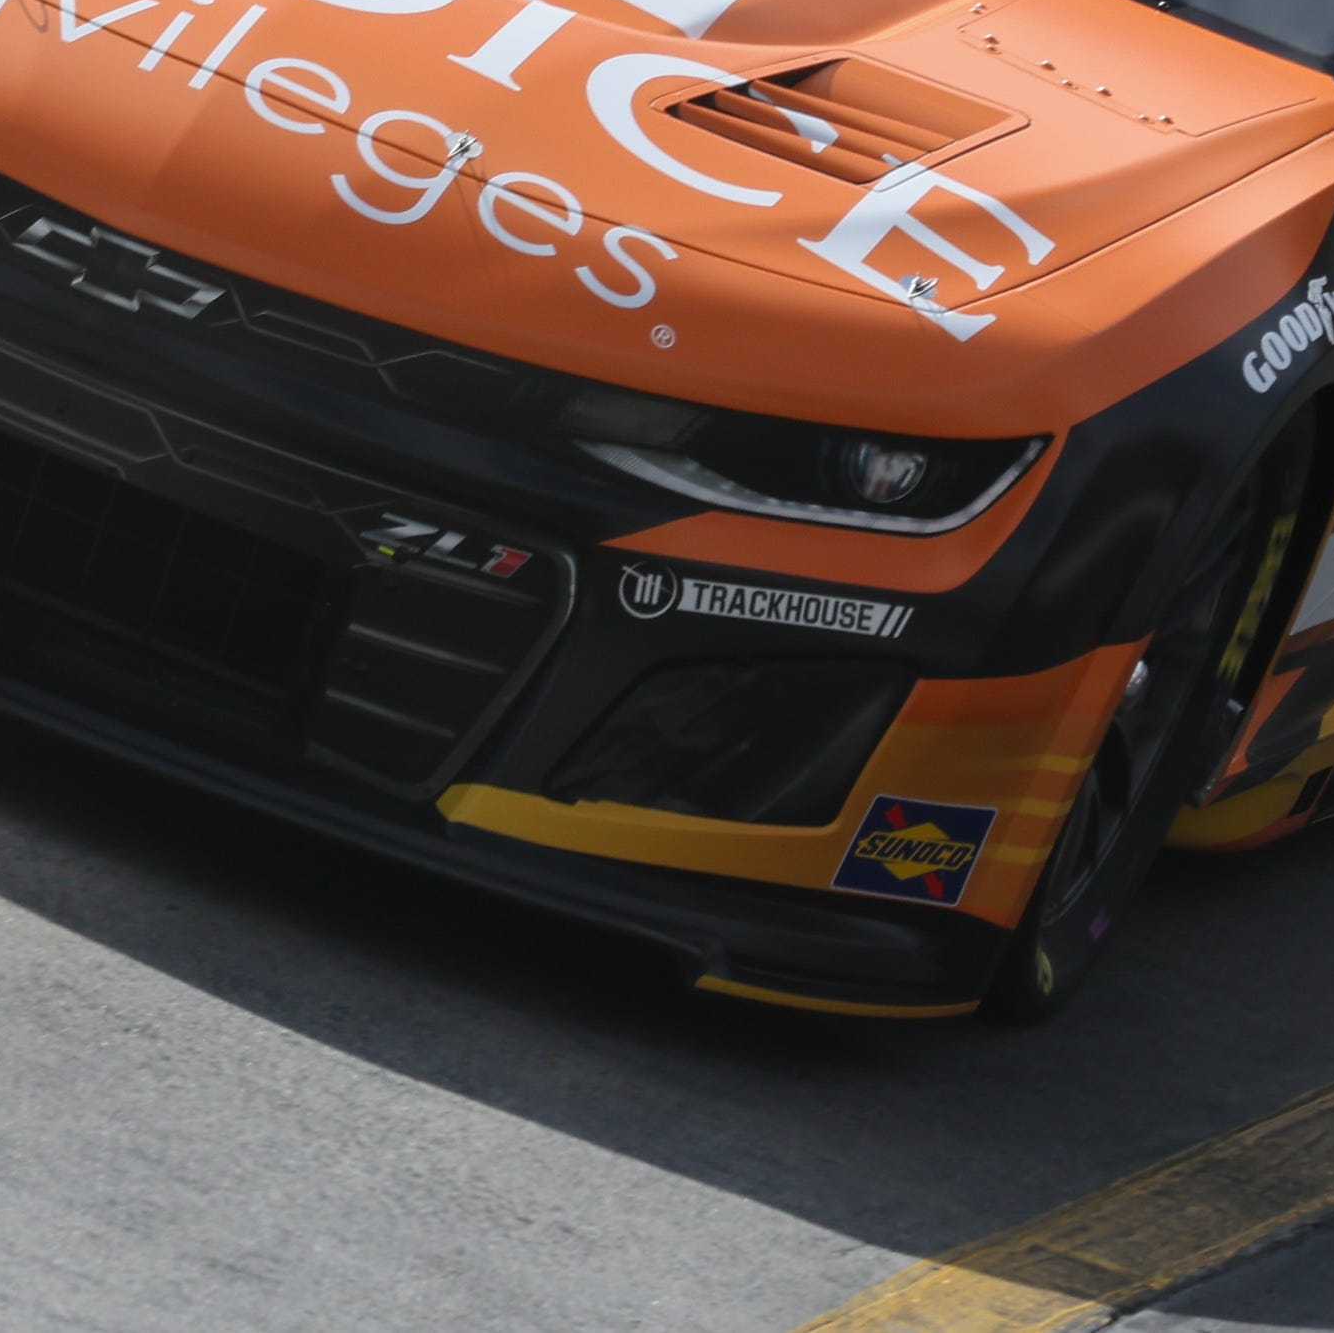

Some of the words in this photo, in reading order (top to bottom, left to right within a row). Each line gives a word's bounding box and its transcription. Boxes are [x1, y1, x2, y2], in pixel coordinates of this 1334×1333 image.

[359, 512, 533, 578] ZL1
[692, 581, 876, 632] TRACKHOUSE
[858, 832, 973, 868] SUNOCO
